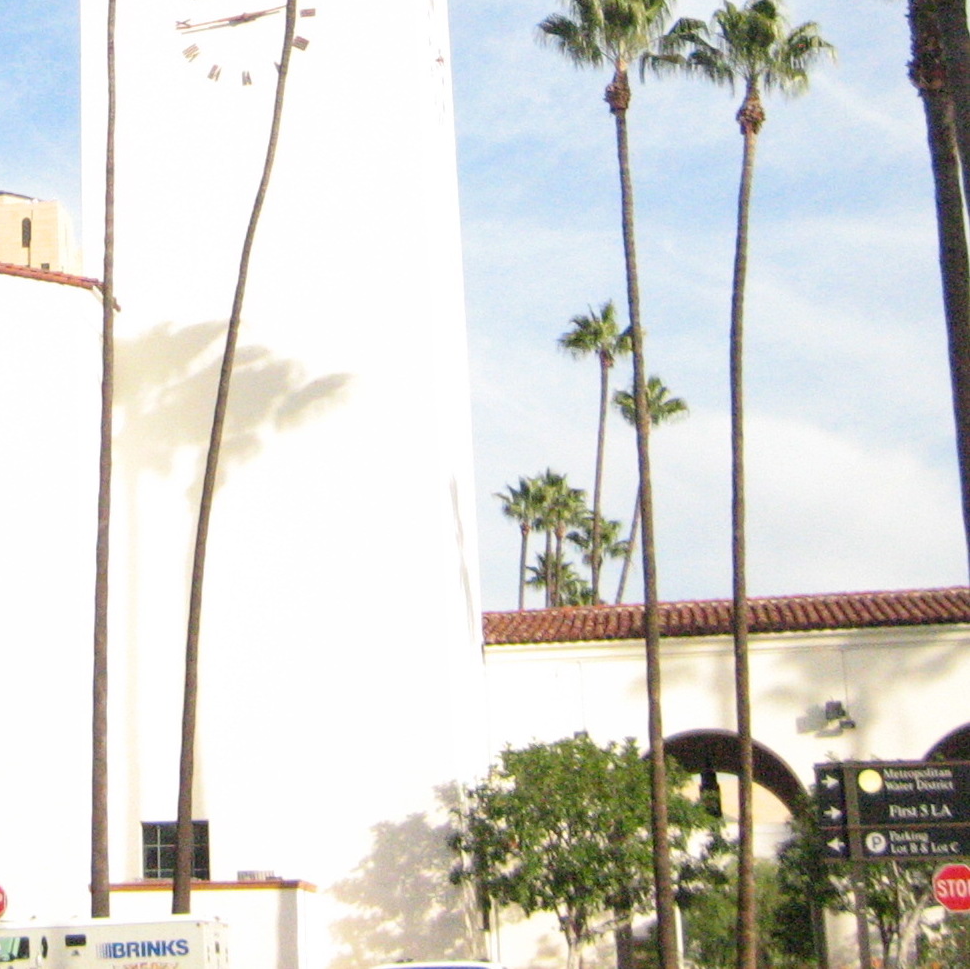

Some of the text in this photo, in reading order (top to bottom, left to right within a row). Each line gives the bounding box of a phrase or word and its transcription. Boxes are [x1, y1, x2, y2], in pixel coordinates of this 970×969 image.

[883, 768, 953, 779] Metropolitan
[889, 804, 918, 818] First
[931, 804, 953, 817] LA
[111, 939, 189, 959] BRINKS
